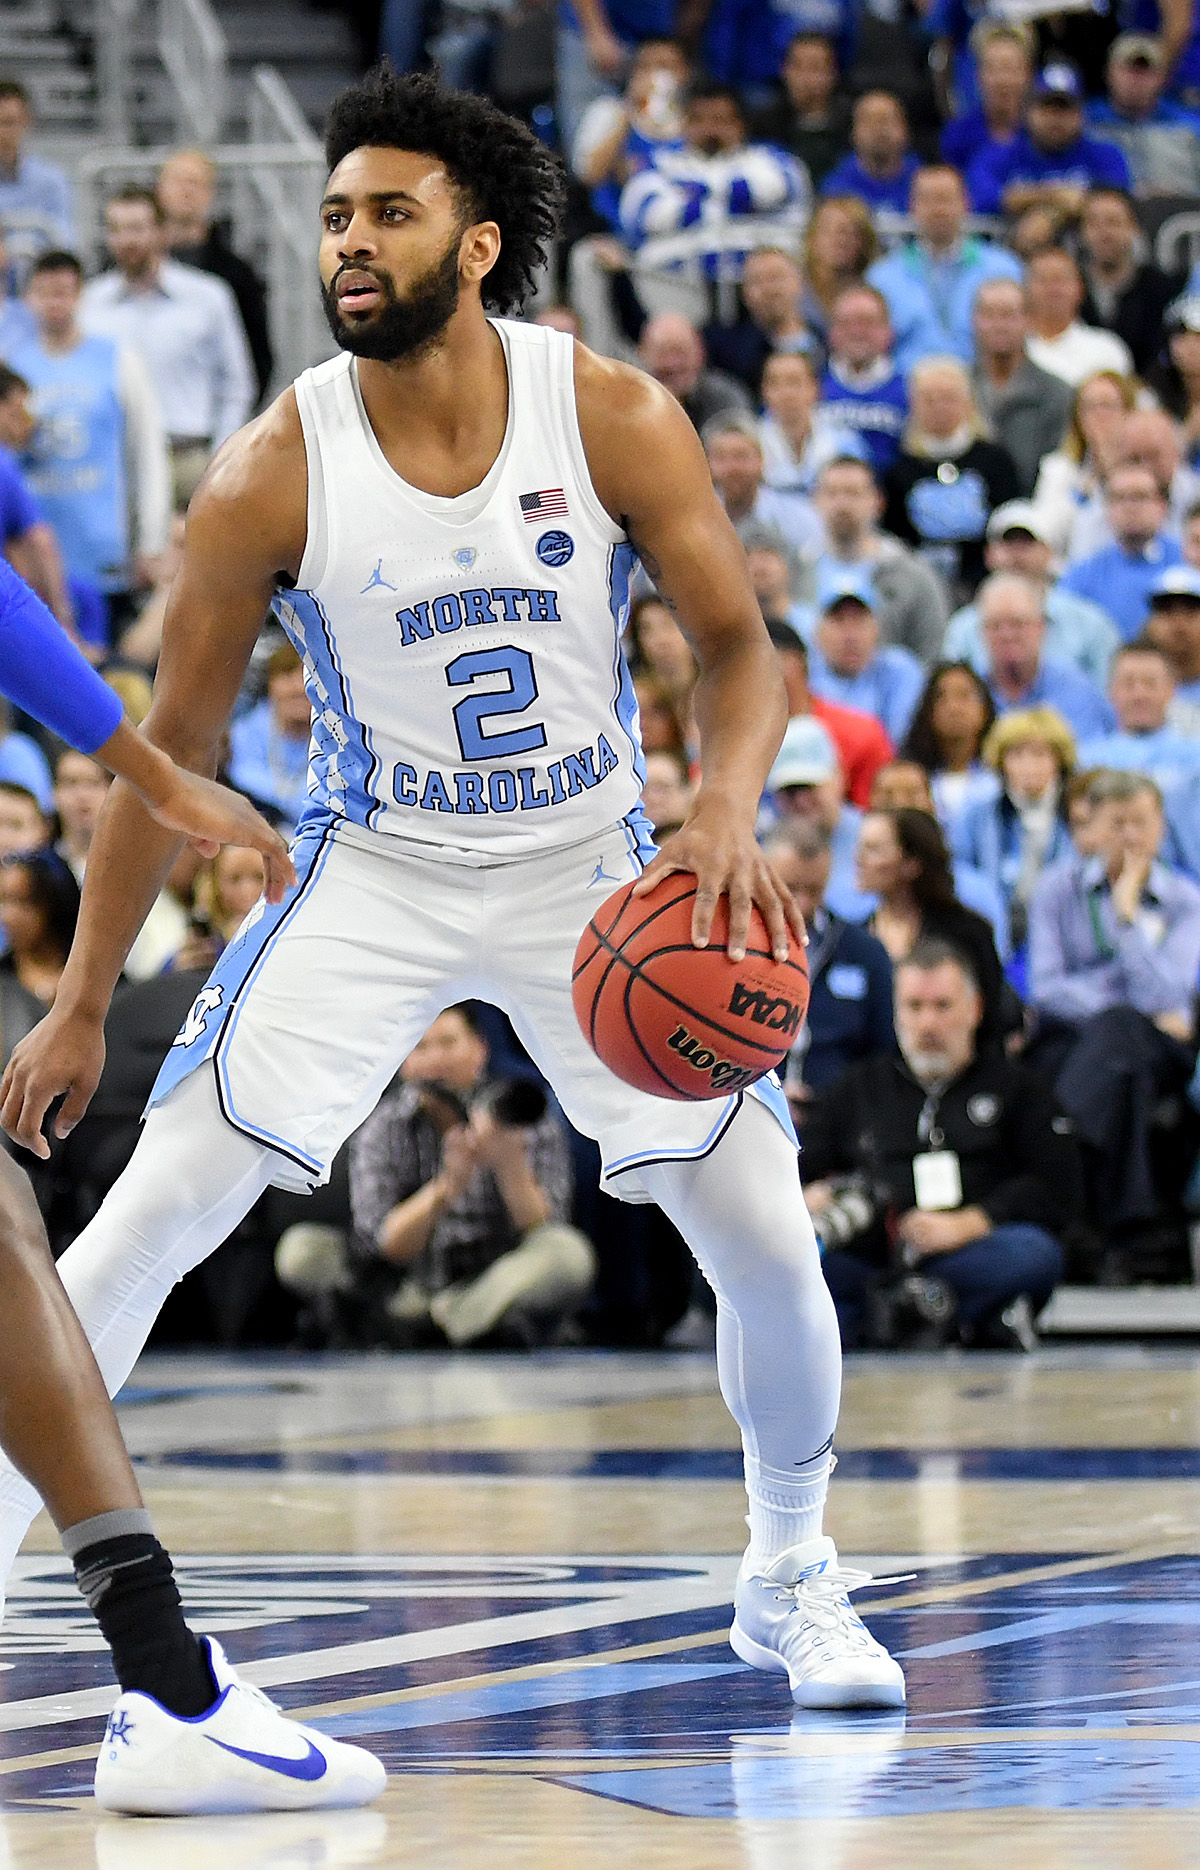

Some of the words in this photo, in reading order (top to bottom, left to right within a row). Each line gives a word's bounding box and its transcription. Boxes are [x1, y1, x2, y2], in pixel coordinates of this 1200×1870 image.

[543, 539, 571, 553] ACC
[396, 588, 561, 647] NORTH
[444, 644, 548, 762] 2
[392, 732, 619, 815] CAROLINA
